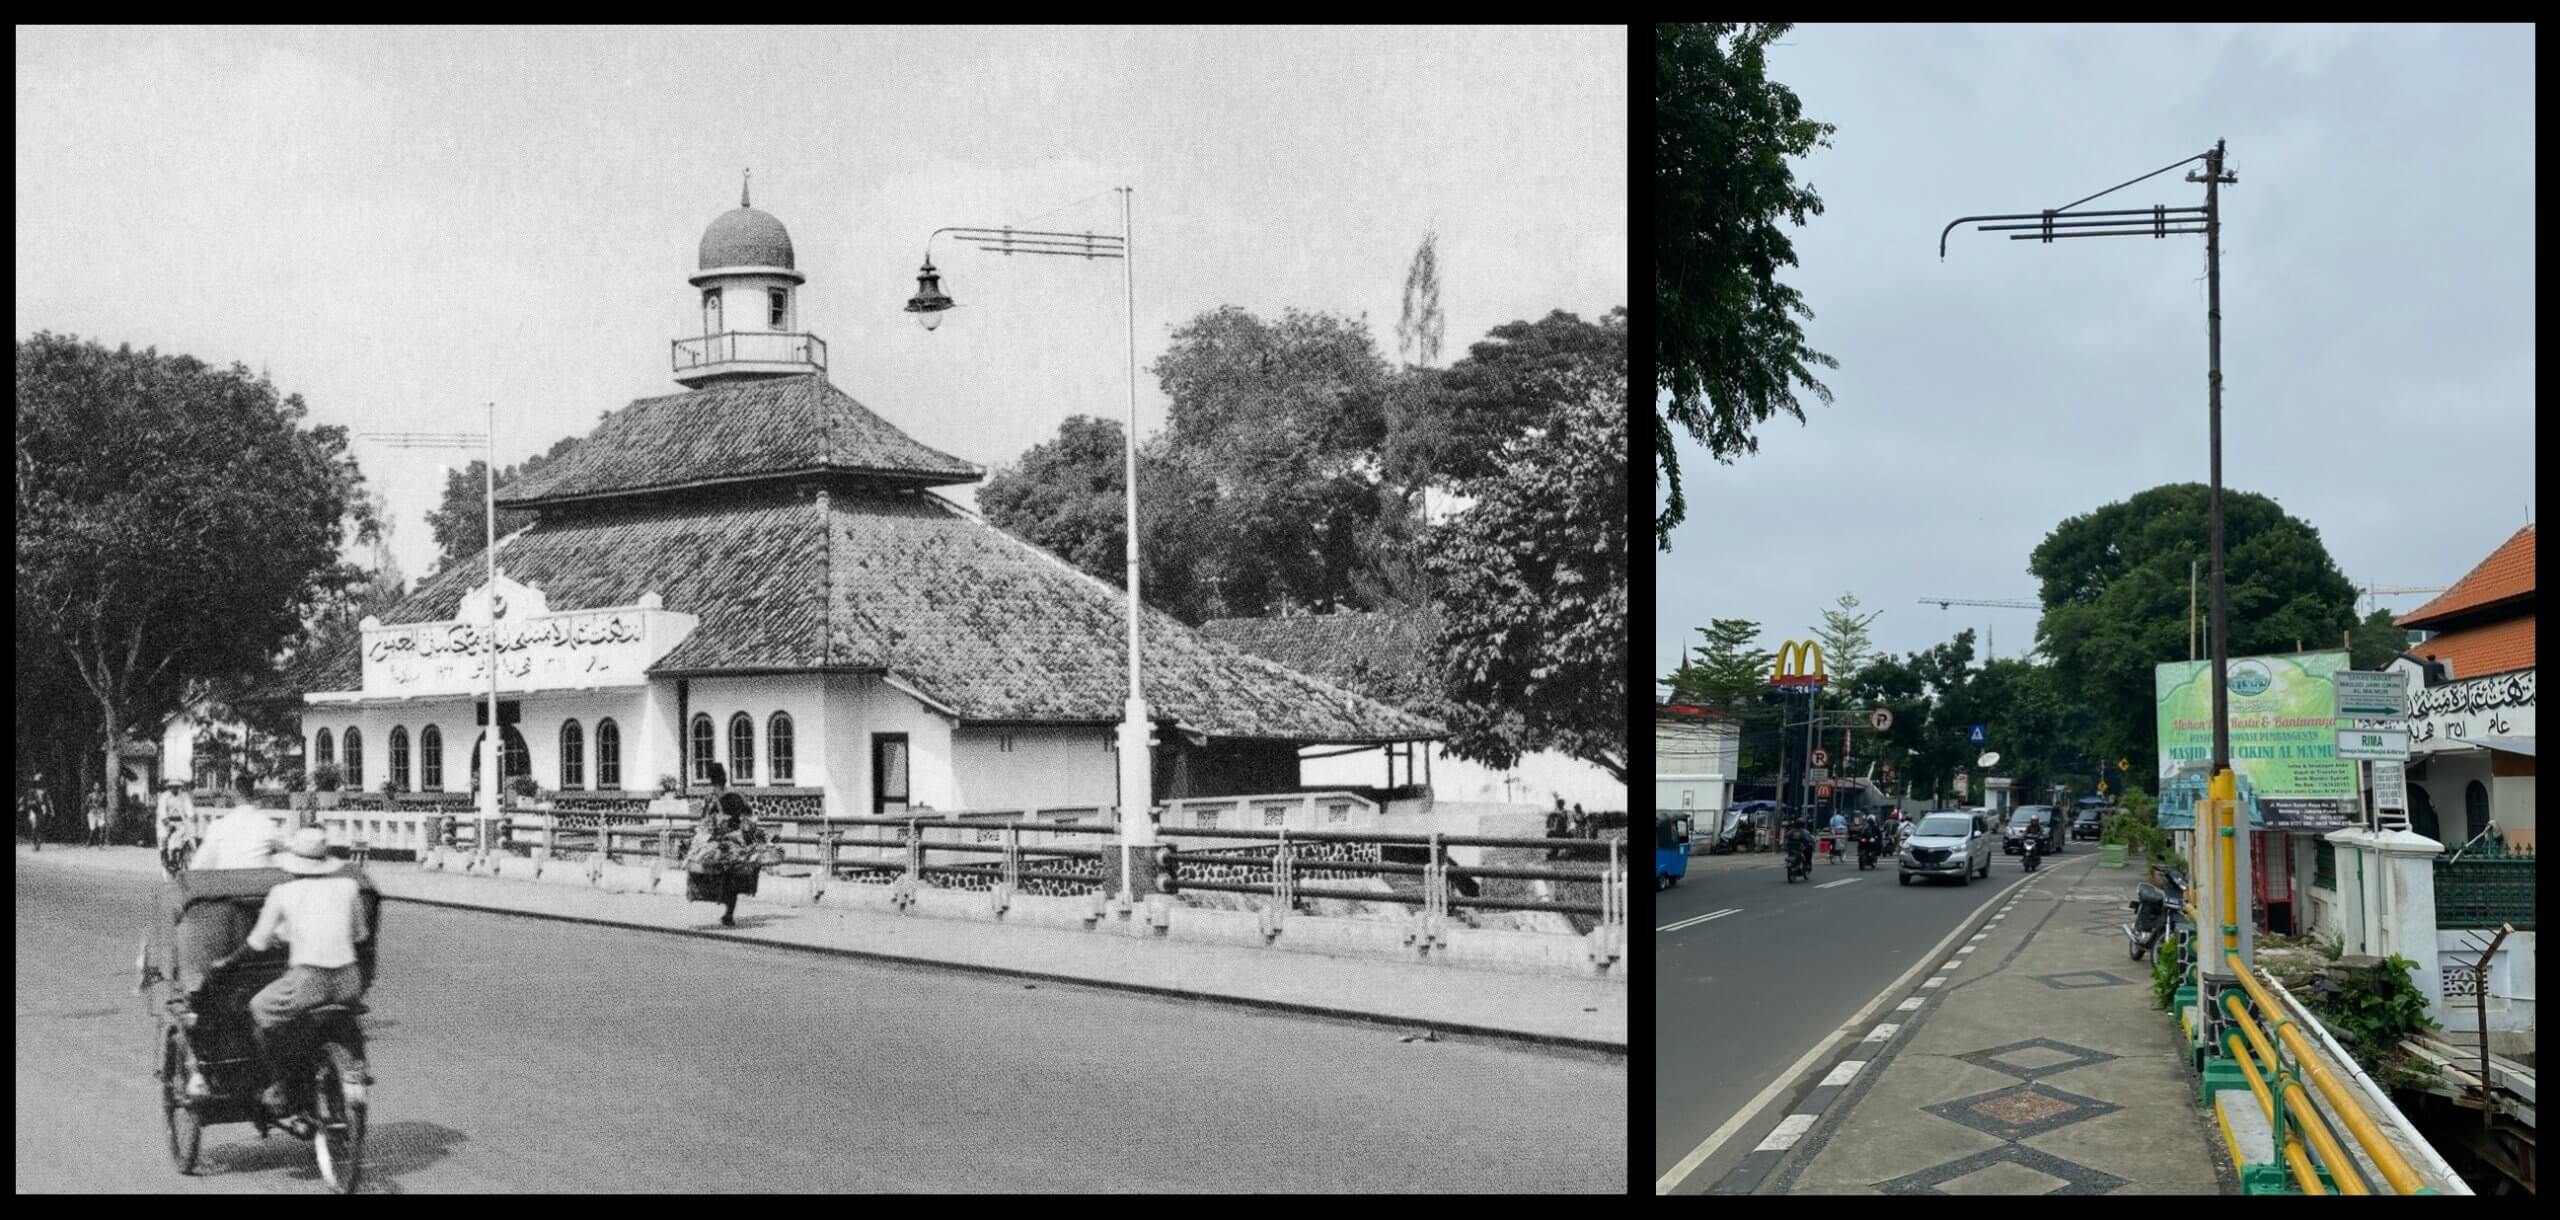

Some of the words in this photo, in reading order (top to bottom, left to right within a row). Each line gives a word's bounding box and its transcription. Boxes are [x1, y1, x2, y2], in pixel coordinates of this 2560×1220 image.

[2361, 734, 2383, 748] RIMA
[2168, 746, 2206, 760] MASJID
[2239, 745, 2274, 759] CIKINI
[2278, 745, 2292, 758] AL
[2297, 743, 2336, 758] MA'MU
